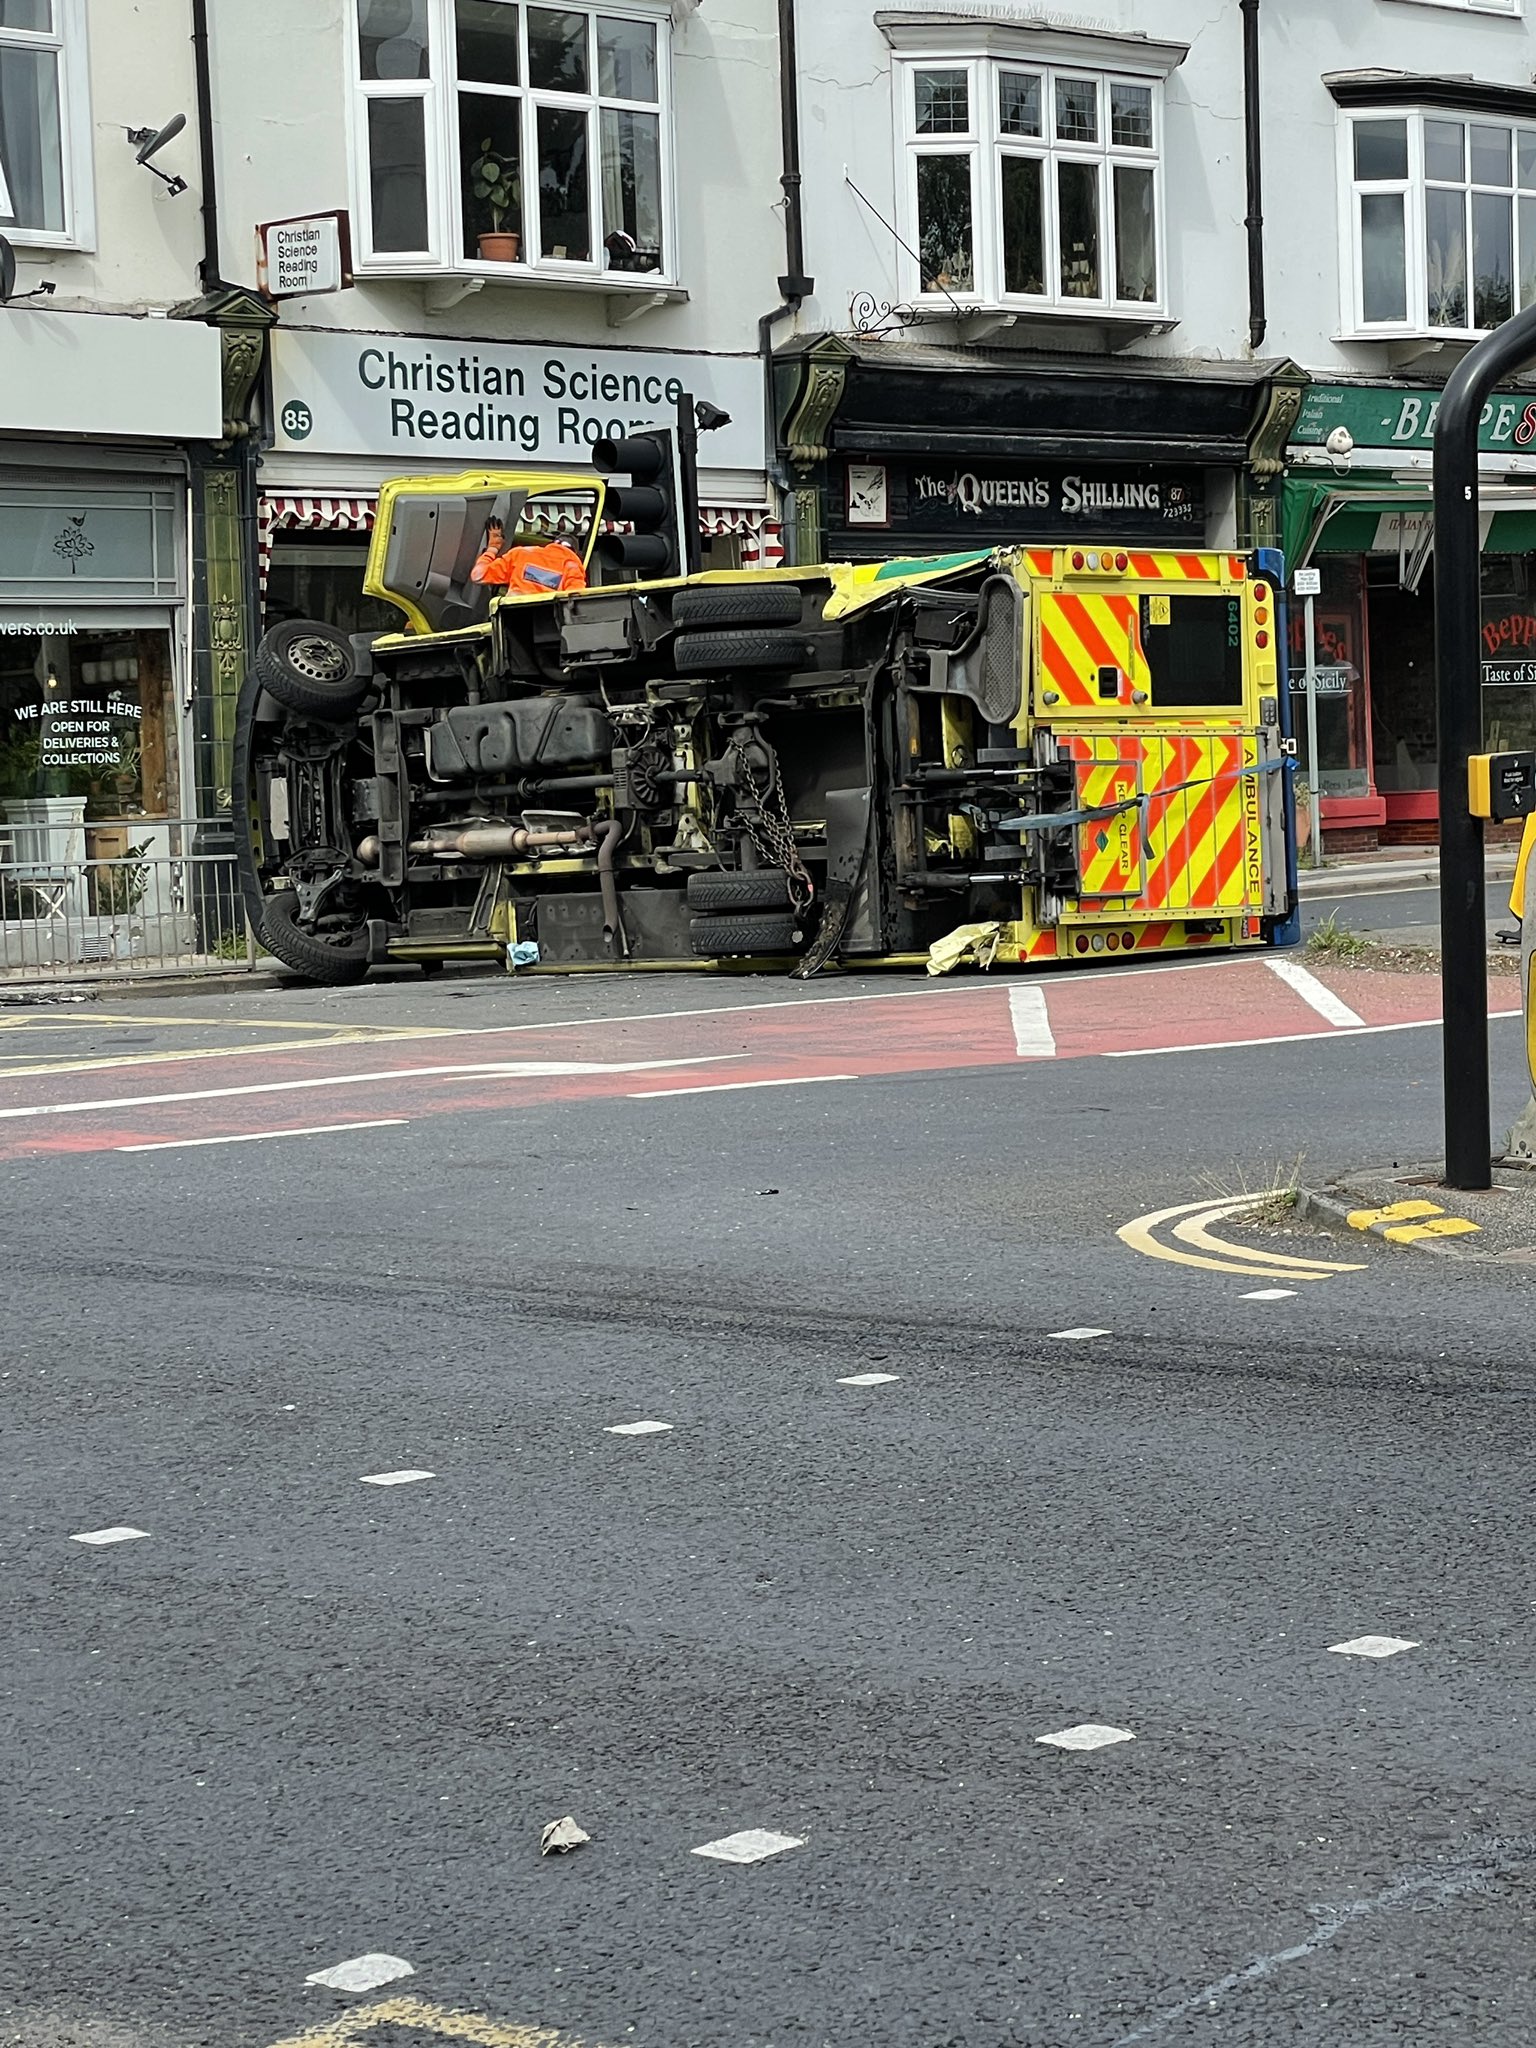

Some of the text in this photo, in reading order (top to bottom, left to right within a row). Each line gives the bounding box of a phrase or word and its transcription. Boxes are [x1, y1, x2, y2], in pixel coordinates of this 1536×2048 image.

[277, 229, 320, 244] Christian
[278, 245, 318, 259] Science
[278, 259, 318, 273] Reading
[279, 275, 307, 288] Room
[358, 348, 684, 405] Christian Science
[283, 410, 311, 431] 85
[391, 398, 655, 452] Reading Roo
[914, 472, 1160, 514] The QUEEN'S SHILLING
[1170, 487, 1183, 501] 87
[1464, 485, 1472, 500] 5
[1227, 600, 1239, 647] 6402
[1482, 665, 1511, 682] Taste
[1513, 663, 1526, 681] of
[1314, 670, 1347, 693] Sicily
[14, 700, 143, 720] WE ARE STILL HERE
[51, 720, 110, 732] OPEN FOR
[43, 736, 119, 749] DELIVERIES &
[42, 752, 121, 765] COLLECTIONS
[1117, 783, 1129, 869] KEP CLEAR
